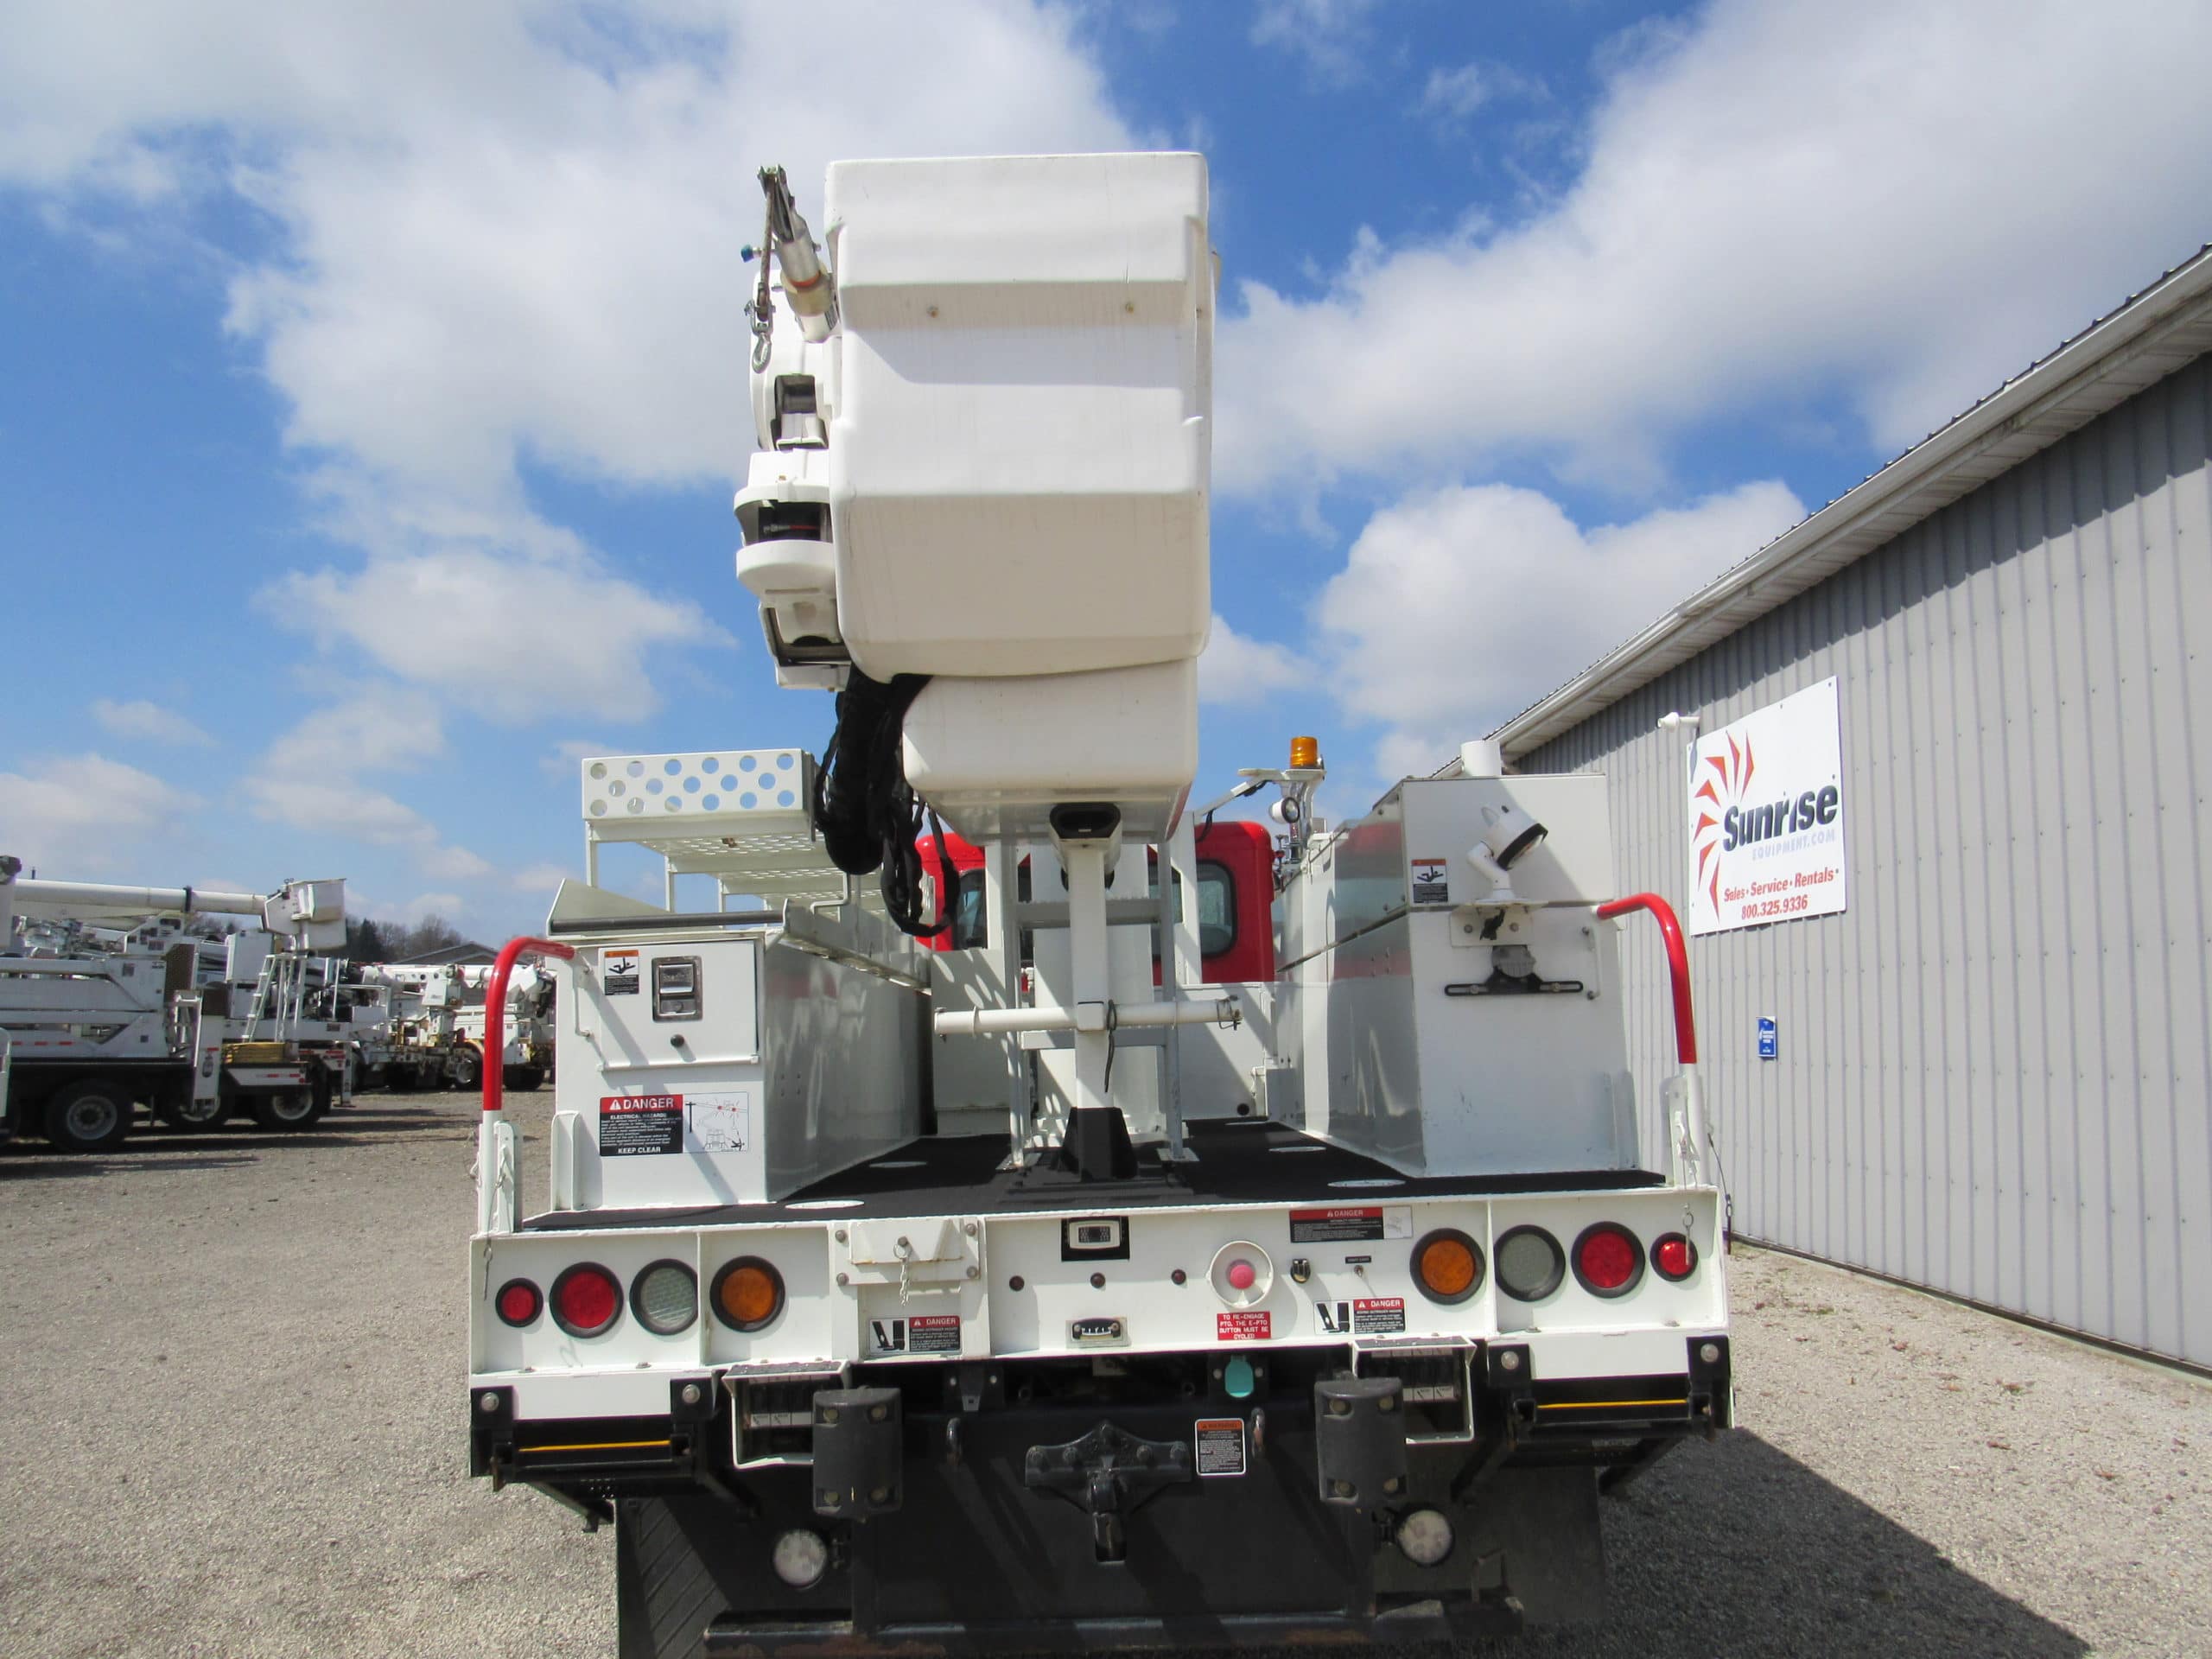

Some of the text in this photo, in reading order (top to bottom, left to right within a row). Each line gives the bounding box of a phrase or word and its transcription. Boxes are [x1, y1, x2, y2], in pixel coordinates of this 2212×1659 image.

[1722, 785, 1838, 852] Sunrise
[1752, 830, 1835, 861] EQUIPMENT.COM
[1724, 867, 1834, 902] Sales Service Rentals
[1741, 893, 1808, 920] 800.325.9336
[623, 1097, 674, 1110] DANGER
